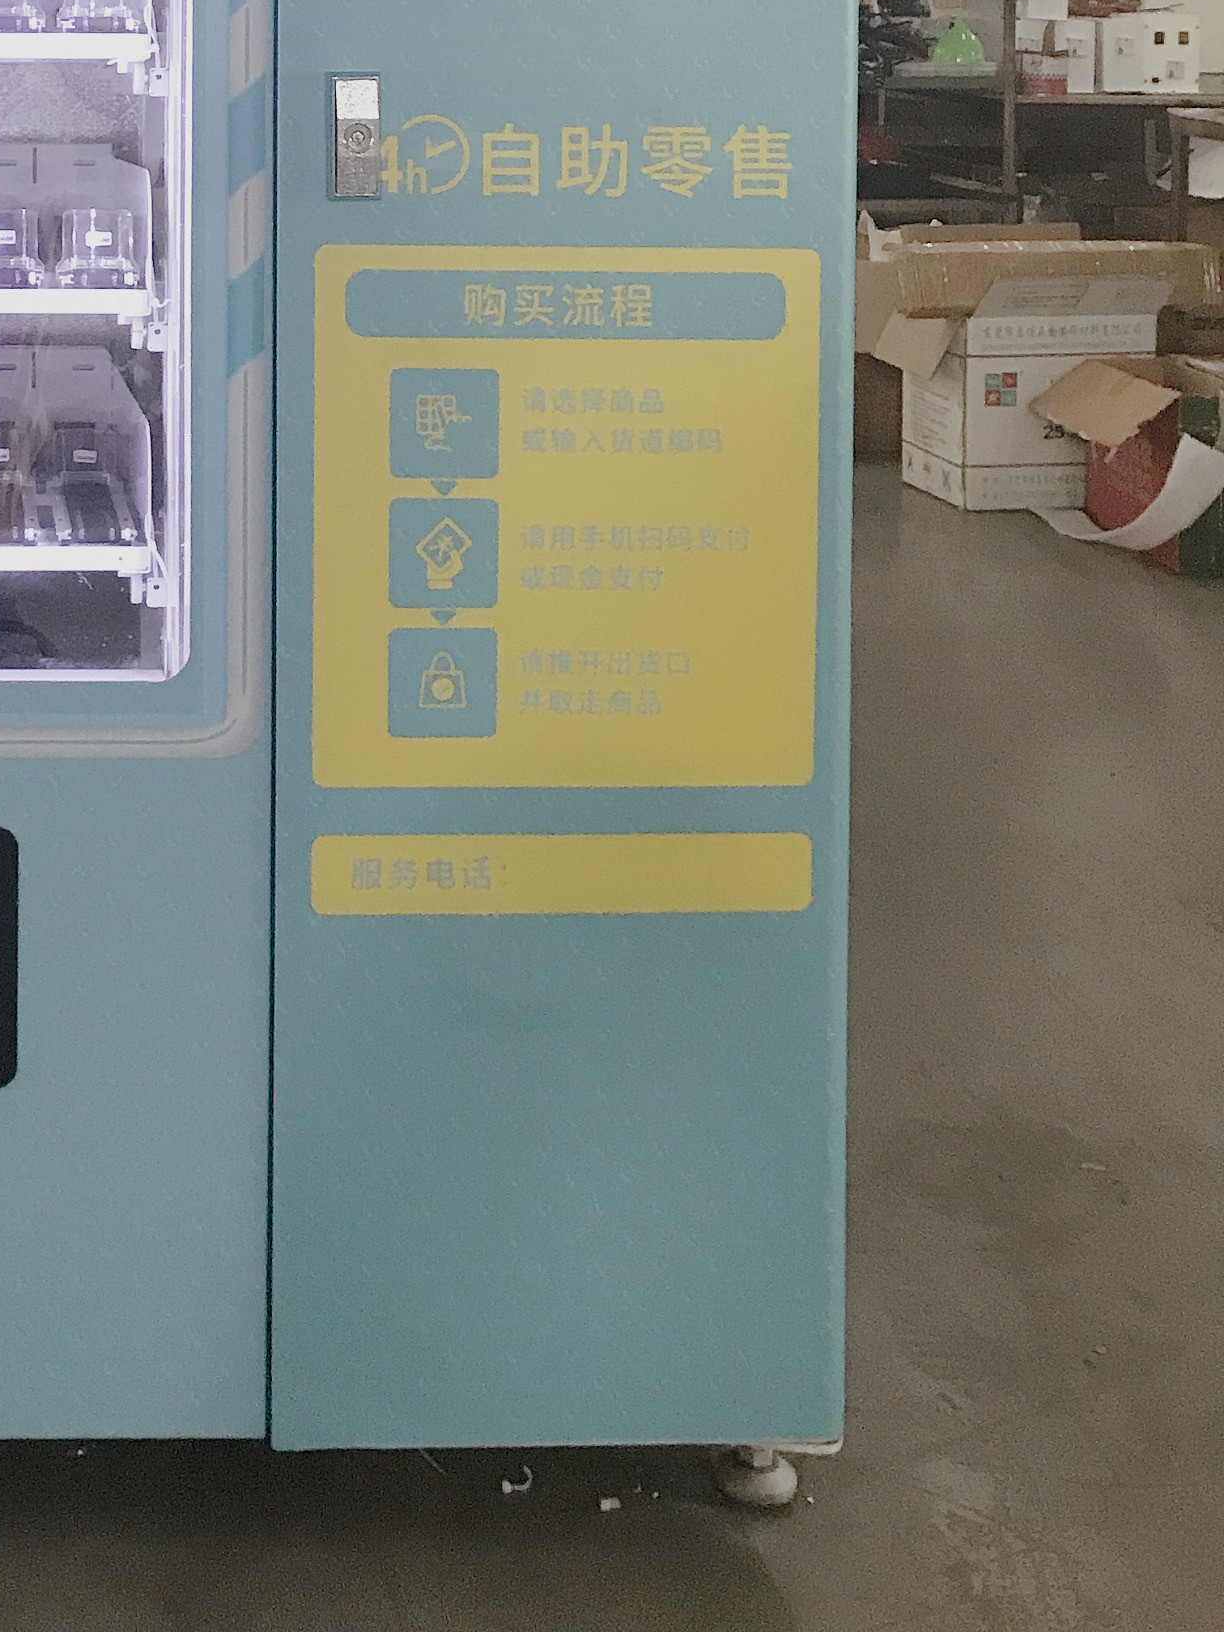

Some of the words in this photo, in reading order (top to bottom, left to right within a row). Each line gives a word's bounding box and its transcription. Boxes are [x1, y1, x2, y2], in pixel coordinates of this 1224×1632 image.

[479, 122, 794, 200] 自助零售
[463, 283, 654, 328] 购买流程
[522, 388, 666, 415] 请选择商品
[522, 428, 723, 454] 或输入货道编码
[521, 523, 753, 552] 请用手机扫码支付
[520, 565, 664, 591] 或现金支付
[519, 688, 663, 716] 并取走商品
